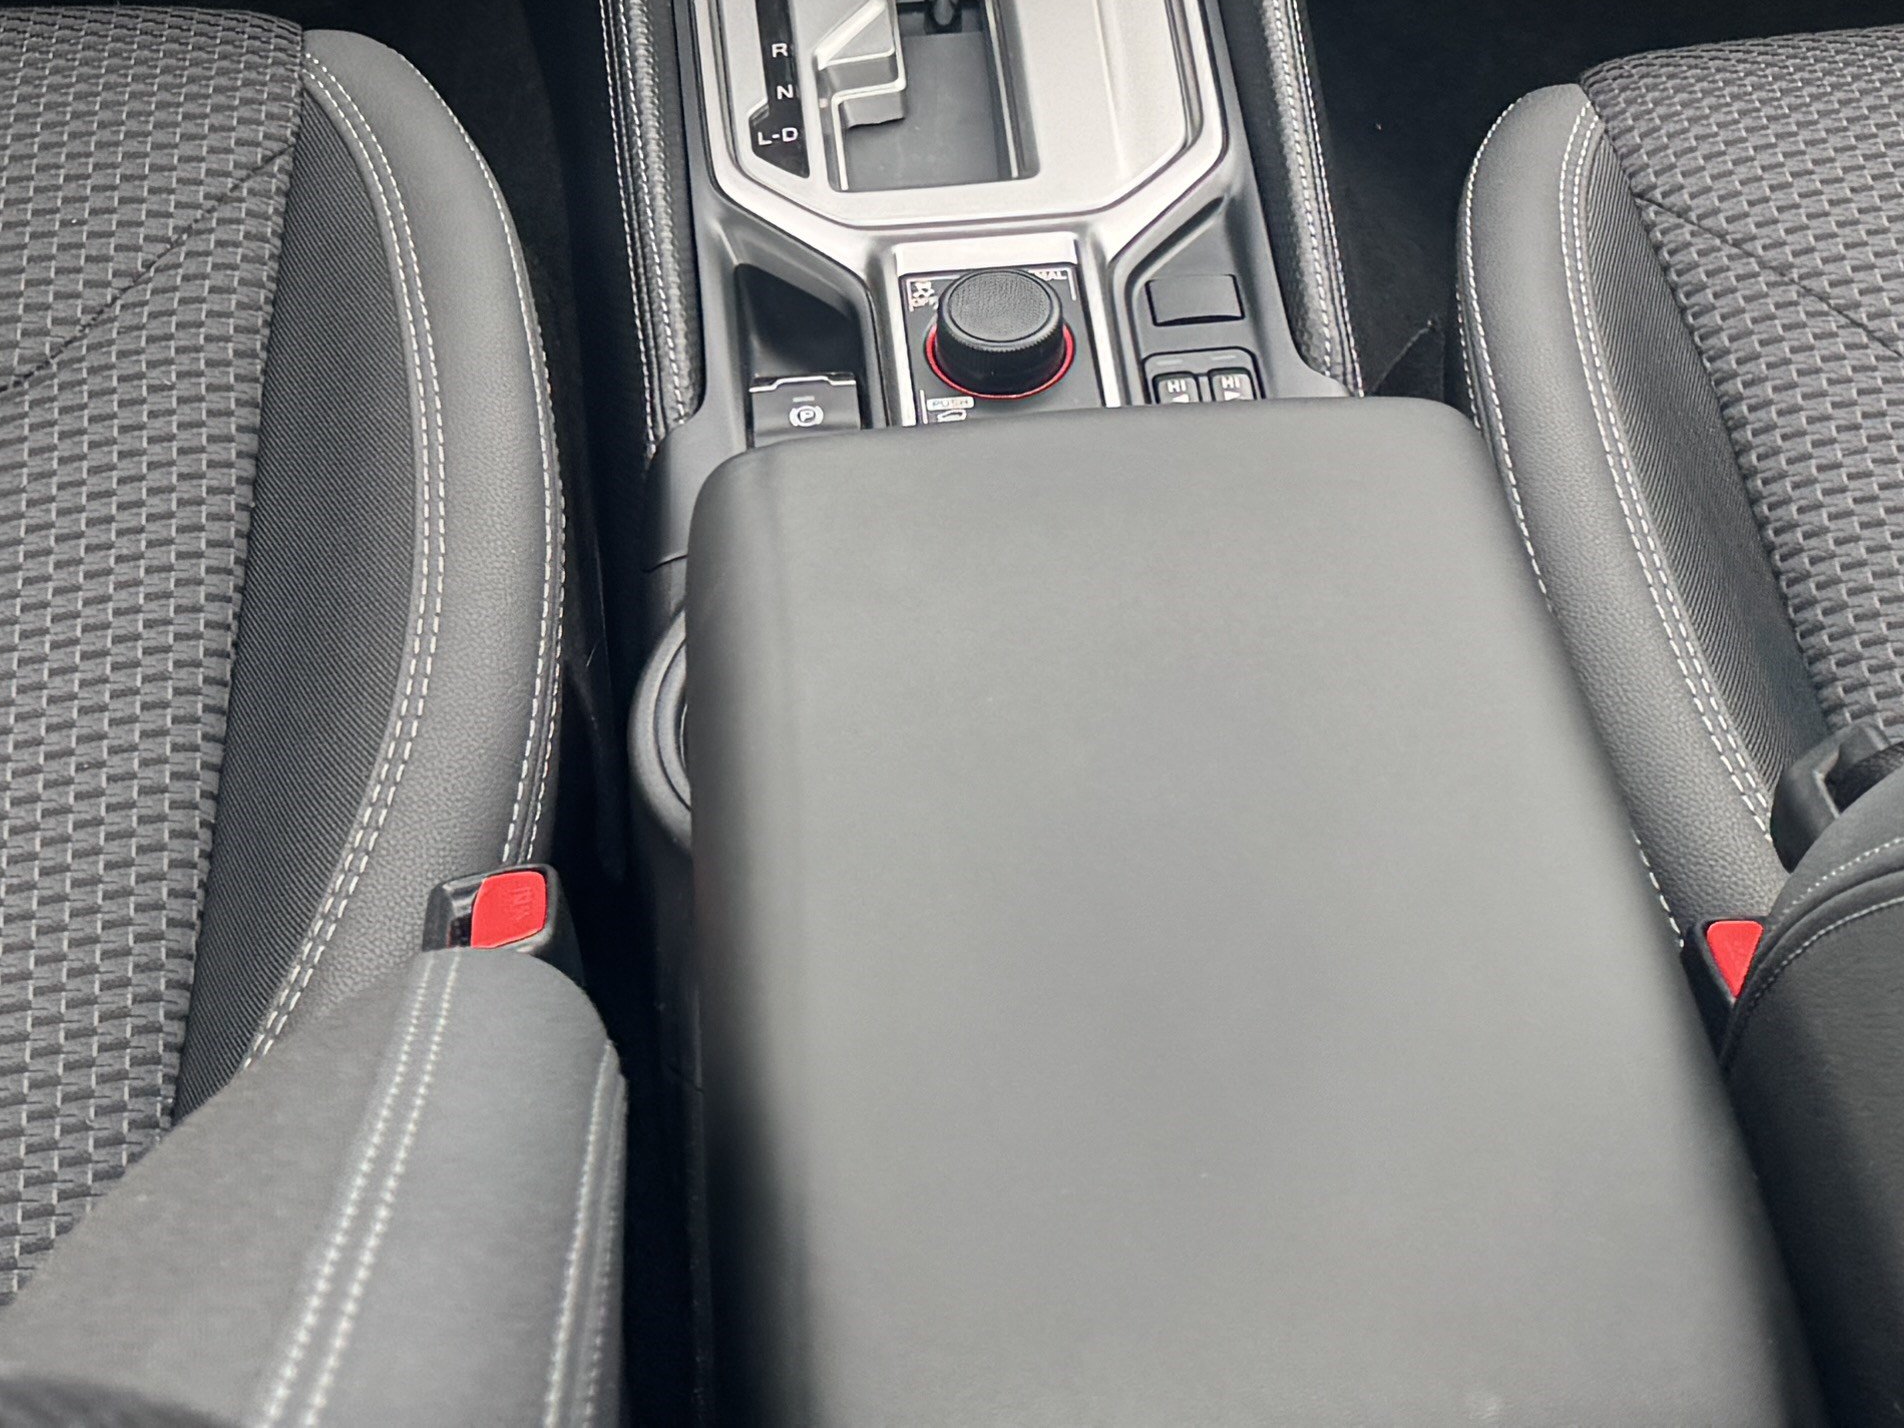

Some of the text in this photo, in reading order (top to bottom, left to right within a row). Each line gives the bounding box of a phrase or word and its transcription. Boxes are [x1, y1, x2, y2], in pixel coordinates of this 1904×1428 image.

[771, 42, 789, 58] R
[776, 83, 794, 100] N
[1166, 378, 1187, 393] HI
[1221, 375, 1241, 389] HI
